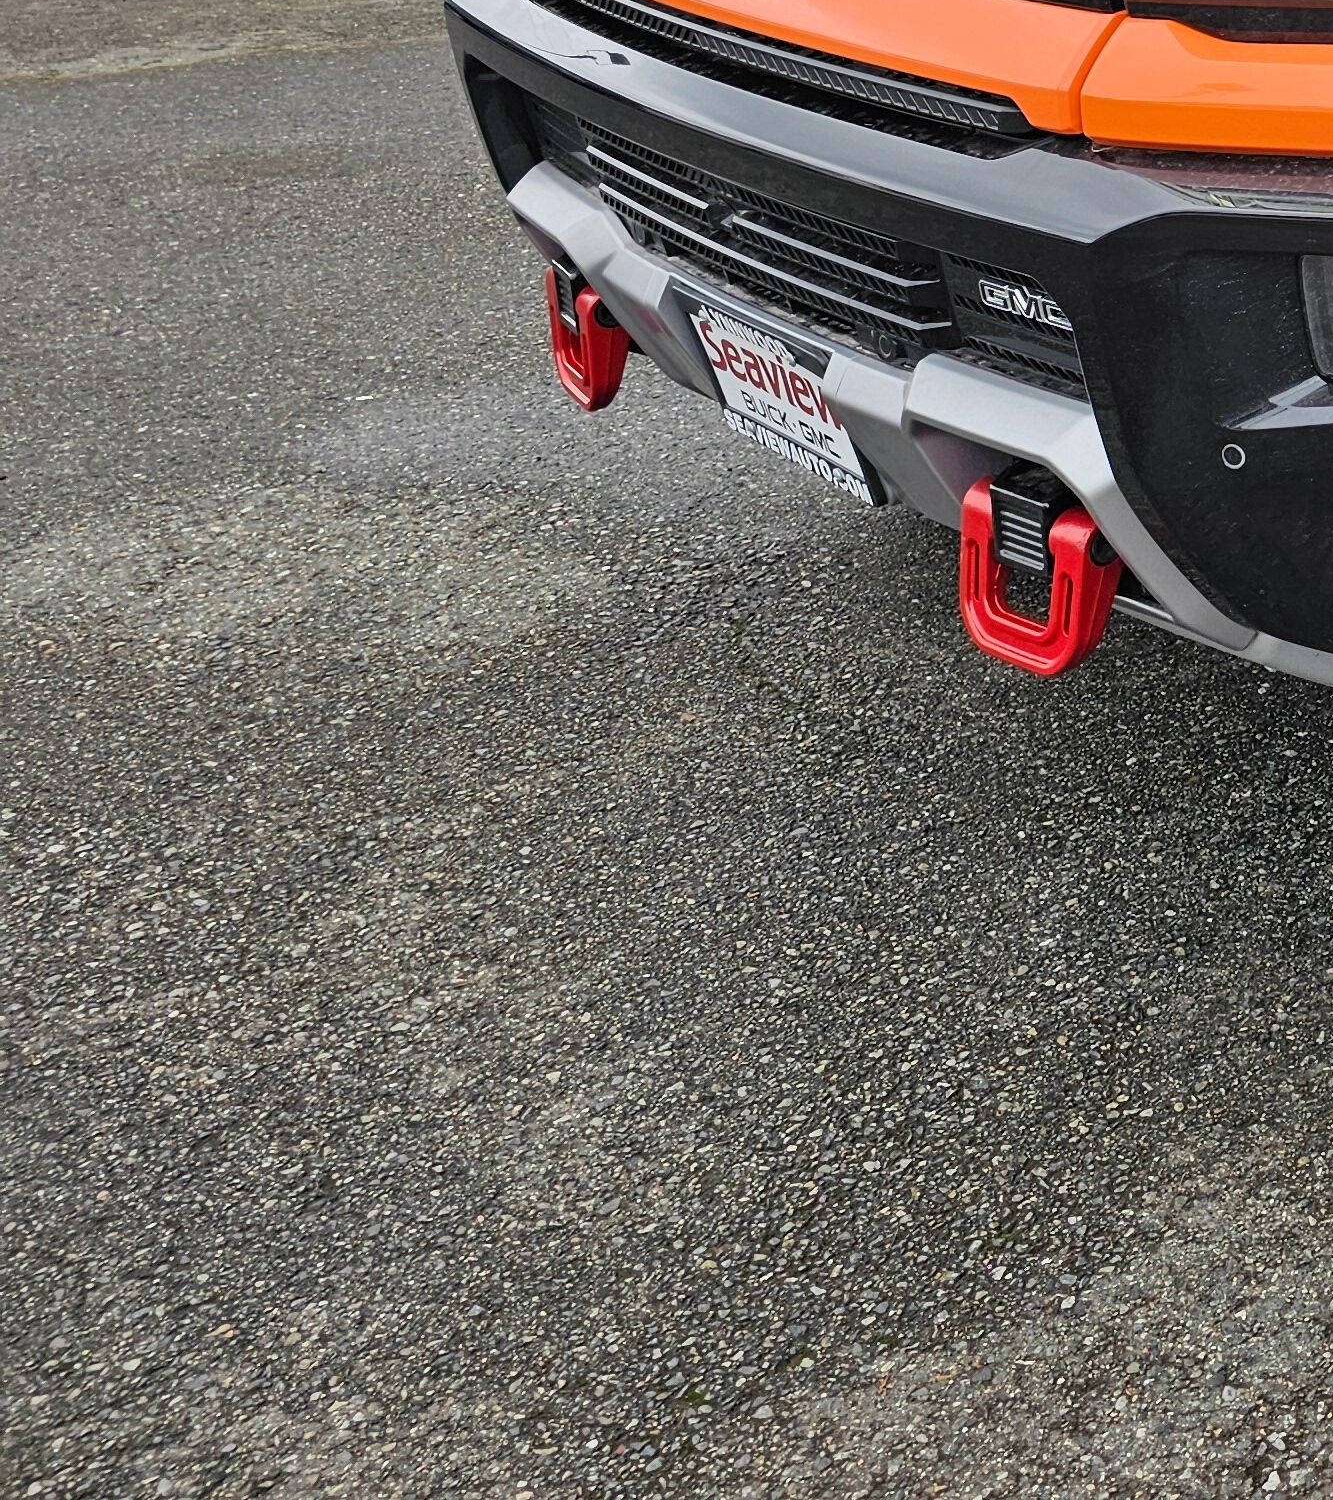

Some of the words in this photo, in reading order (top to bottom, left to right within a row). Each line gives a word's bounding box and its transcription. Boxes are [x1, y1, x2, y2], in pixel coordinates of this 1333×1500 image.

[977, 279, 1074, 332] GMC
[740, 389, 796, 435] BUICK
[799, 419, 842, 460] GMC
